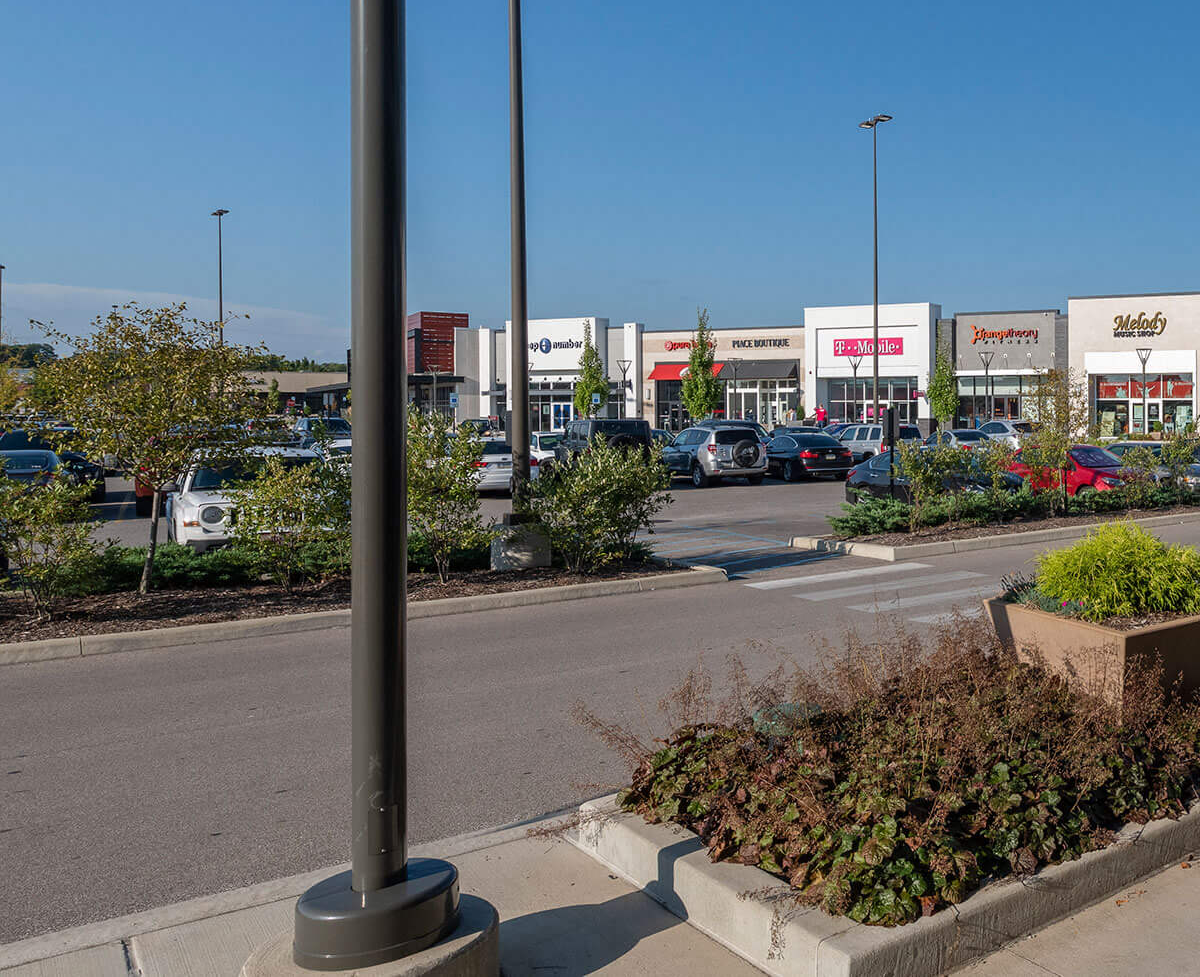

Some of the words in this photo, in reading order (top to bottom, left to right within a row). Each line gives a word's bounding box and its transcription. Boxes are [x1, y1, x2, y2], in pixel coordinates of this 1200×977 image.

[1112, 311, 1168, 336] Melody
[1113, 330, 1136, 338] MUSIC
[1137, 330, 1156, 338] SHOP
[754, 338, 790, 349] BOUTIQUE
